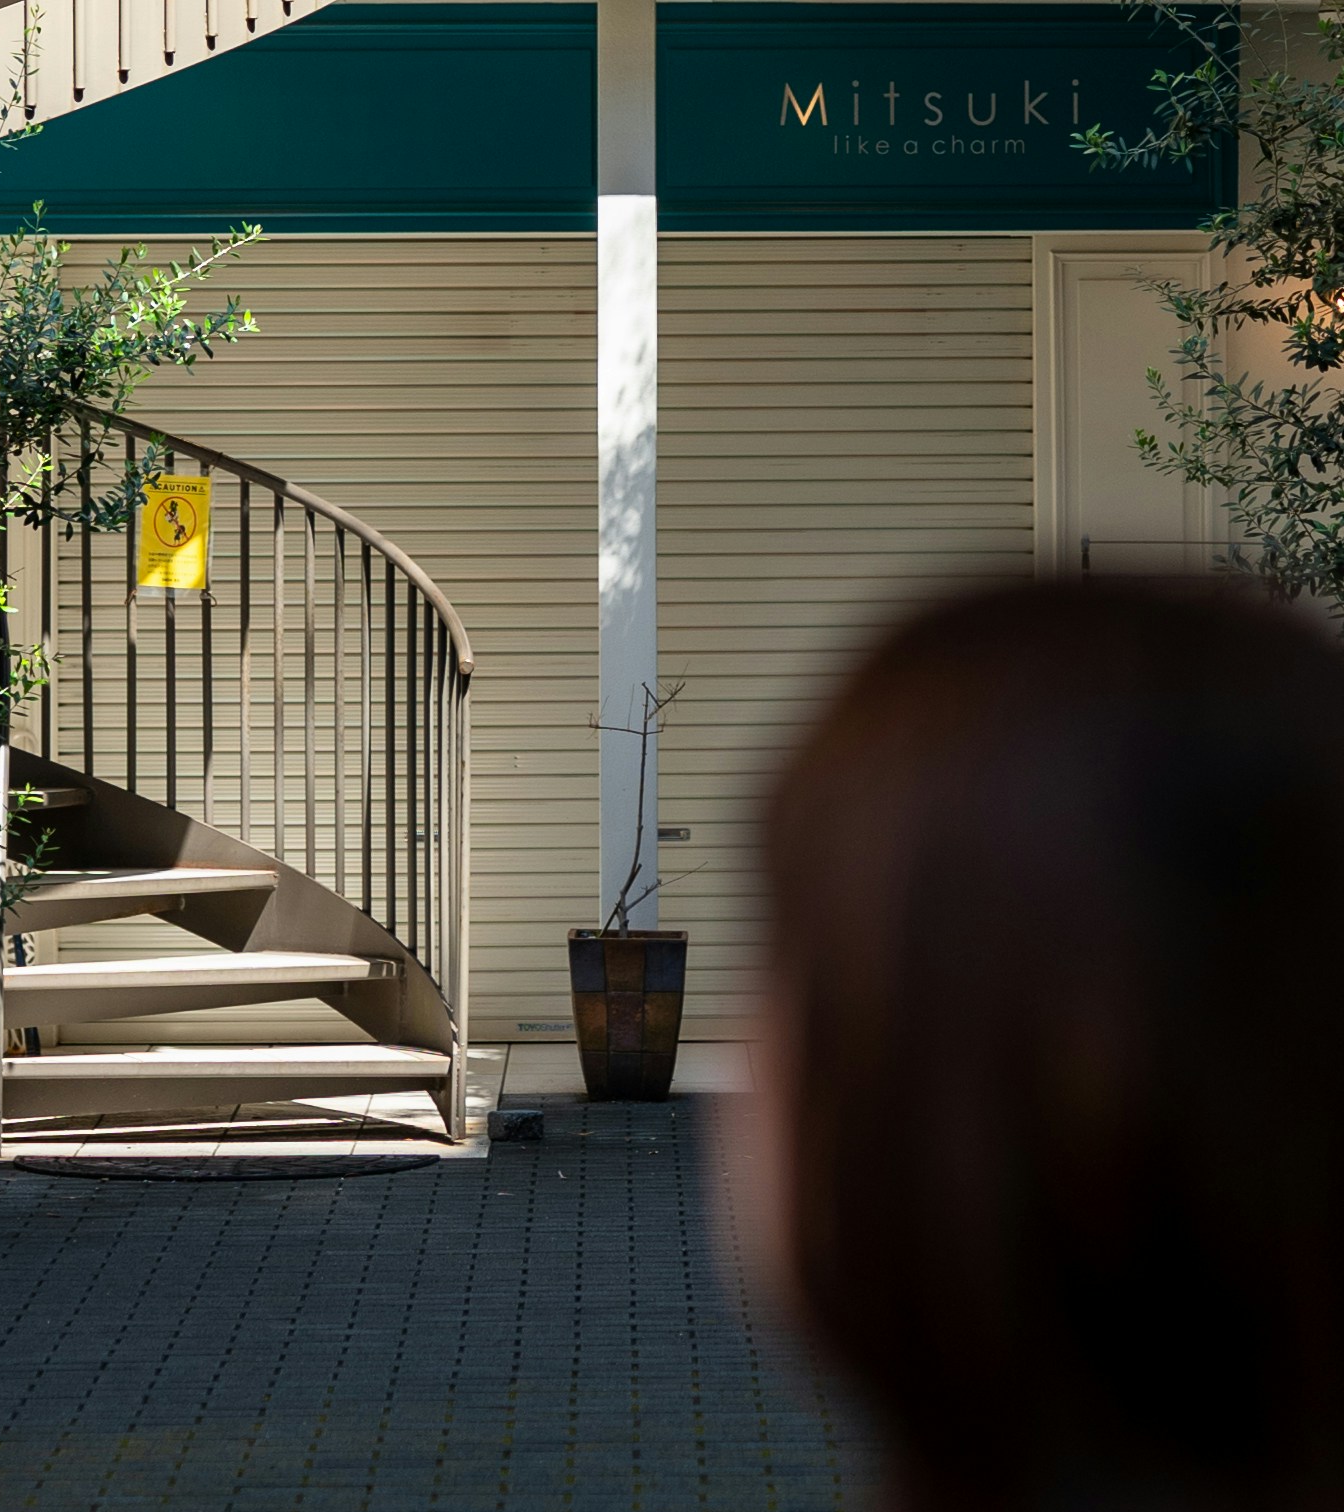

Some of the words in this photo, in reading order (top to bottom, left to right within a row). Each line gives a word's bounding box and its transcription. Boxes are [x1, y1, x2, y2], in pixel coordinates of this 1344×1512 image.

[779, 78, 1080, 127] Mitsuki
[833, 134, 891, 156] like
[902, 139, 920, 156] a
[931, 134, 1027, 156] charm
[157, 483, 198, 493] CAUTION
